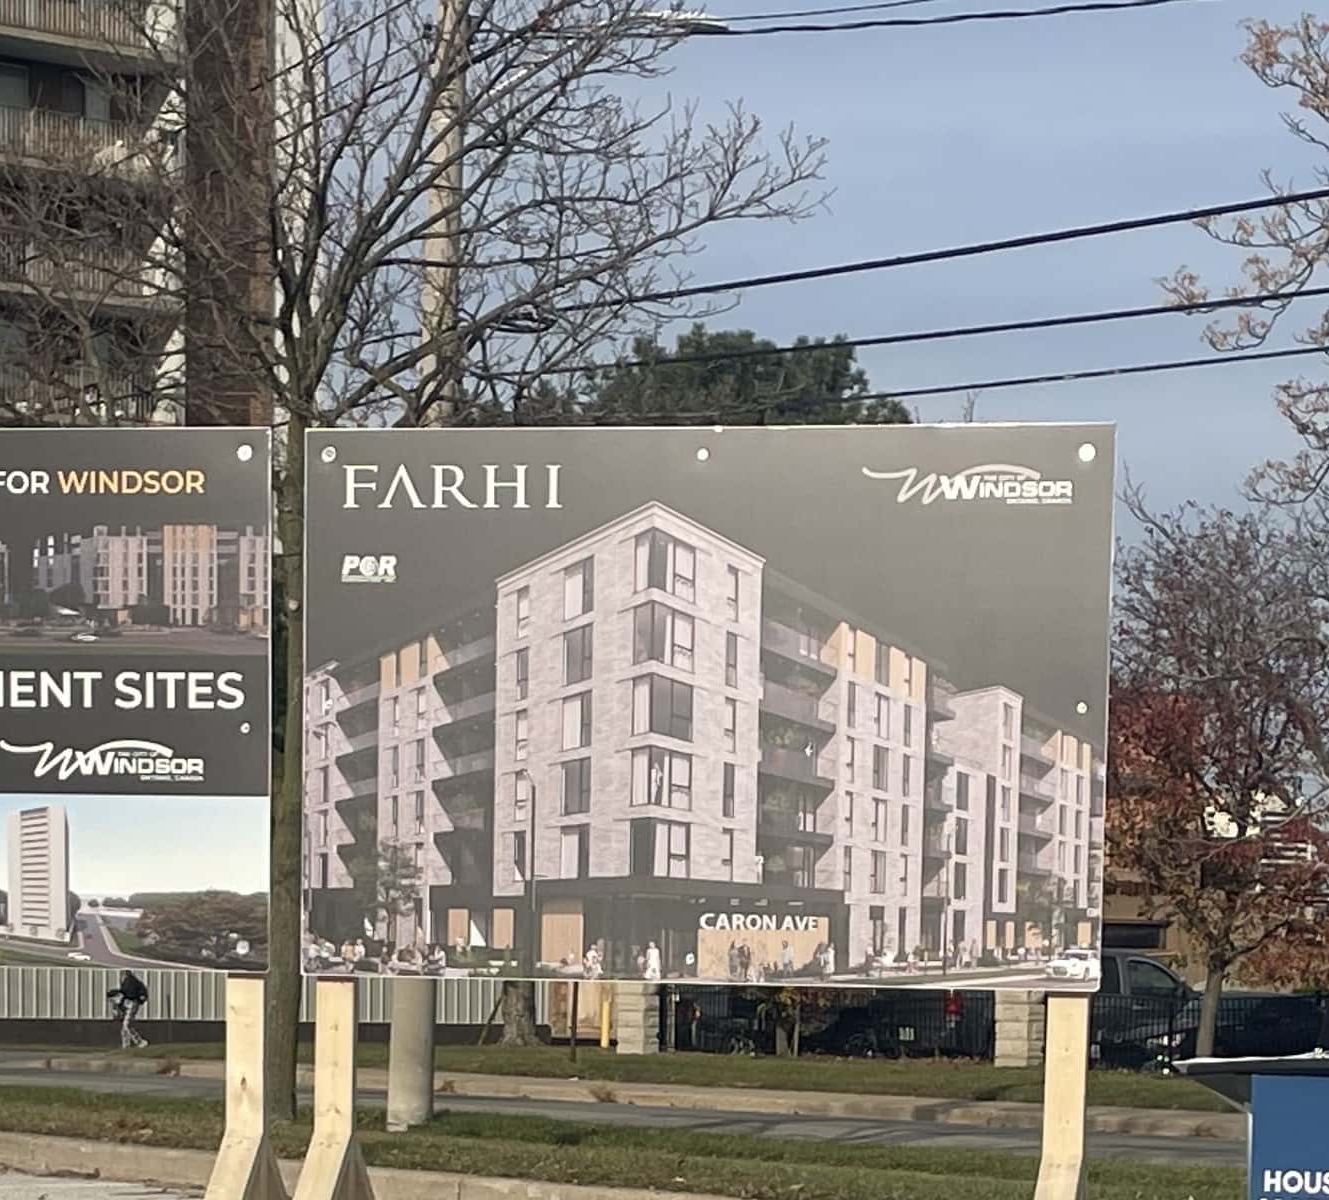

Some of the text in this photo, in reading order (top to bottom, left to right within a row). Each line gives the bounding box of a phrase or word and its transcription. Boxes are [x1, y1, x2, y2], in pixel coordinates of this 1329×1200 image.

[57, 470, 205, 494] WINDSOR
[342, 464, 563, 509] FARHI
[940, 475, 1073, 500] WINDSOR
[114, 671, 246, 709] SITES
[75, 751, 204, 775] WINDSOR
[699, 913, 819, 931] CARON AVE
